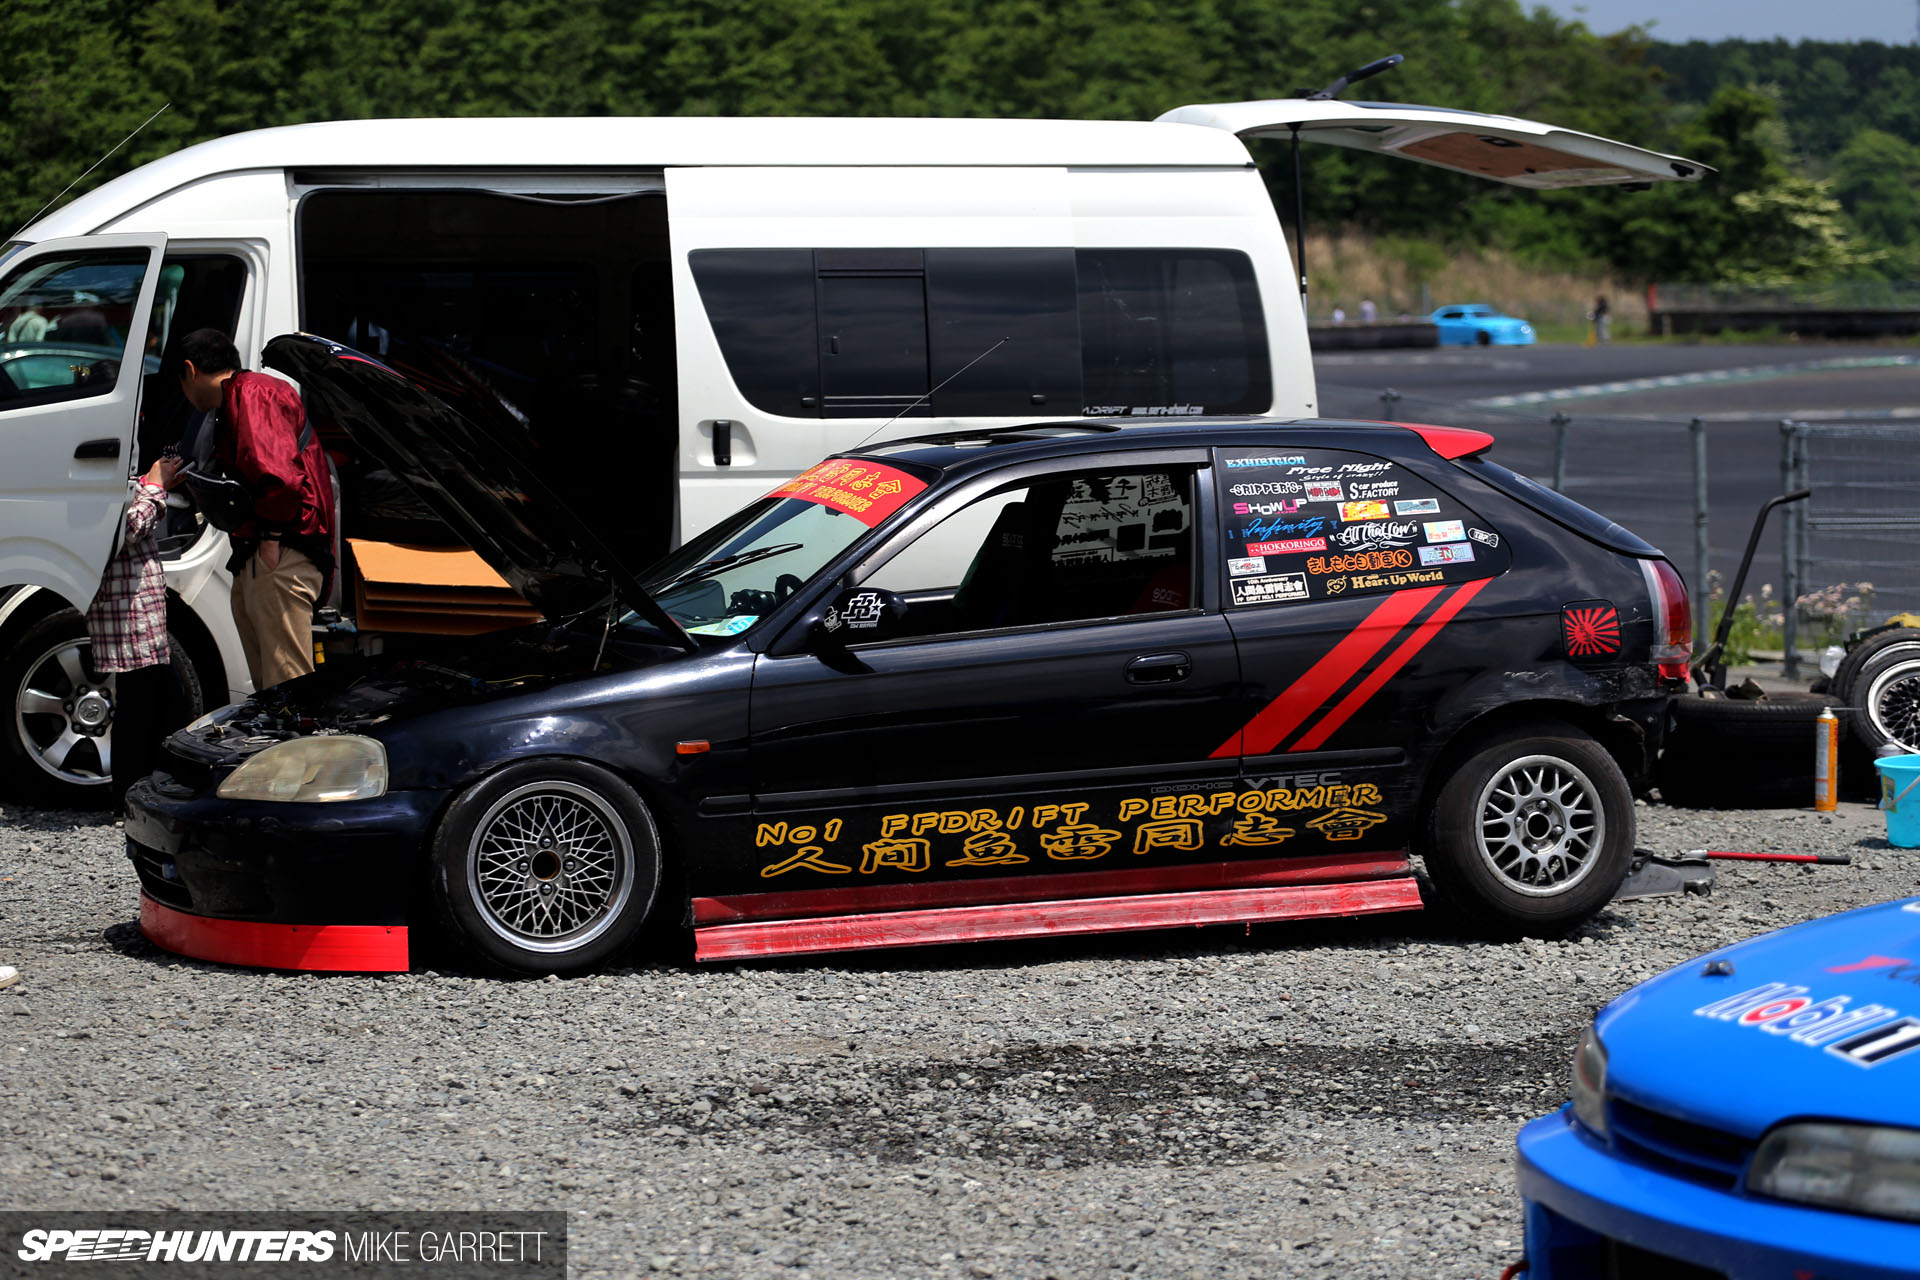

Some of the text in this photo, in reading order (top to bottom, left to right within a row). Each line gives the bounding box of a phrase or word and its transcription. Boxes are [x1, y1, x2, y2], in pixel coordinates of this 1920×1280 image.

[1225, 456, 1306, 468] EXHIBITION
[1286, 462, 1393, 475] Free Night
[1371, 480, 1398, 489] produce
[1260, 539, 1326, 552] HOKKORINGO
[1428, 547, 1465, 560] ZENKI
[1351, 576, 1389, 588] Heart
[1390, 575, 1407, 585] Up
[1406, 571, 1443, 582] World
[1275, 591, 1306, 599] PERFORMER
[1151, 772, 1341, 794] DOHC VTEC
[1118, 783, 1383, 822] PERFORMER
[1693, 982, 1898, 1047] Mobil
